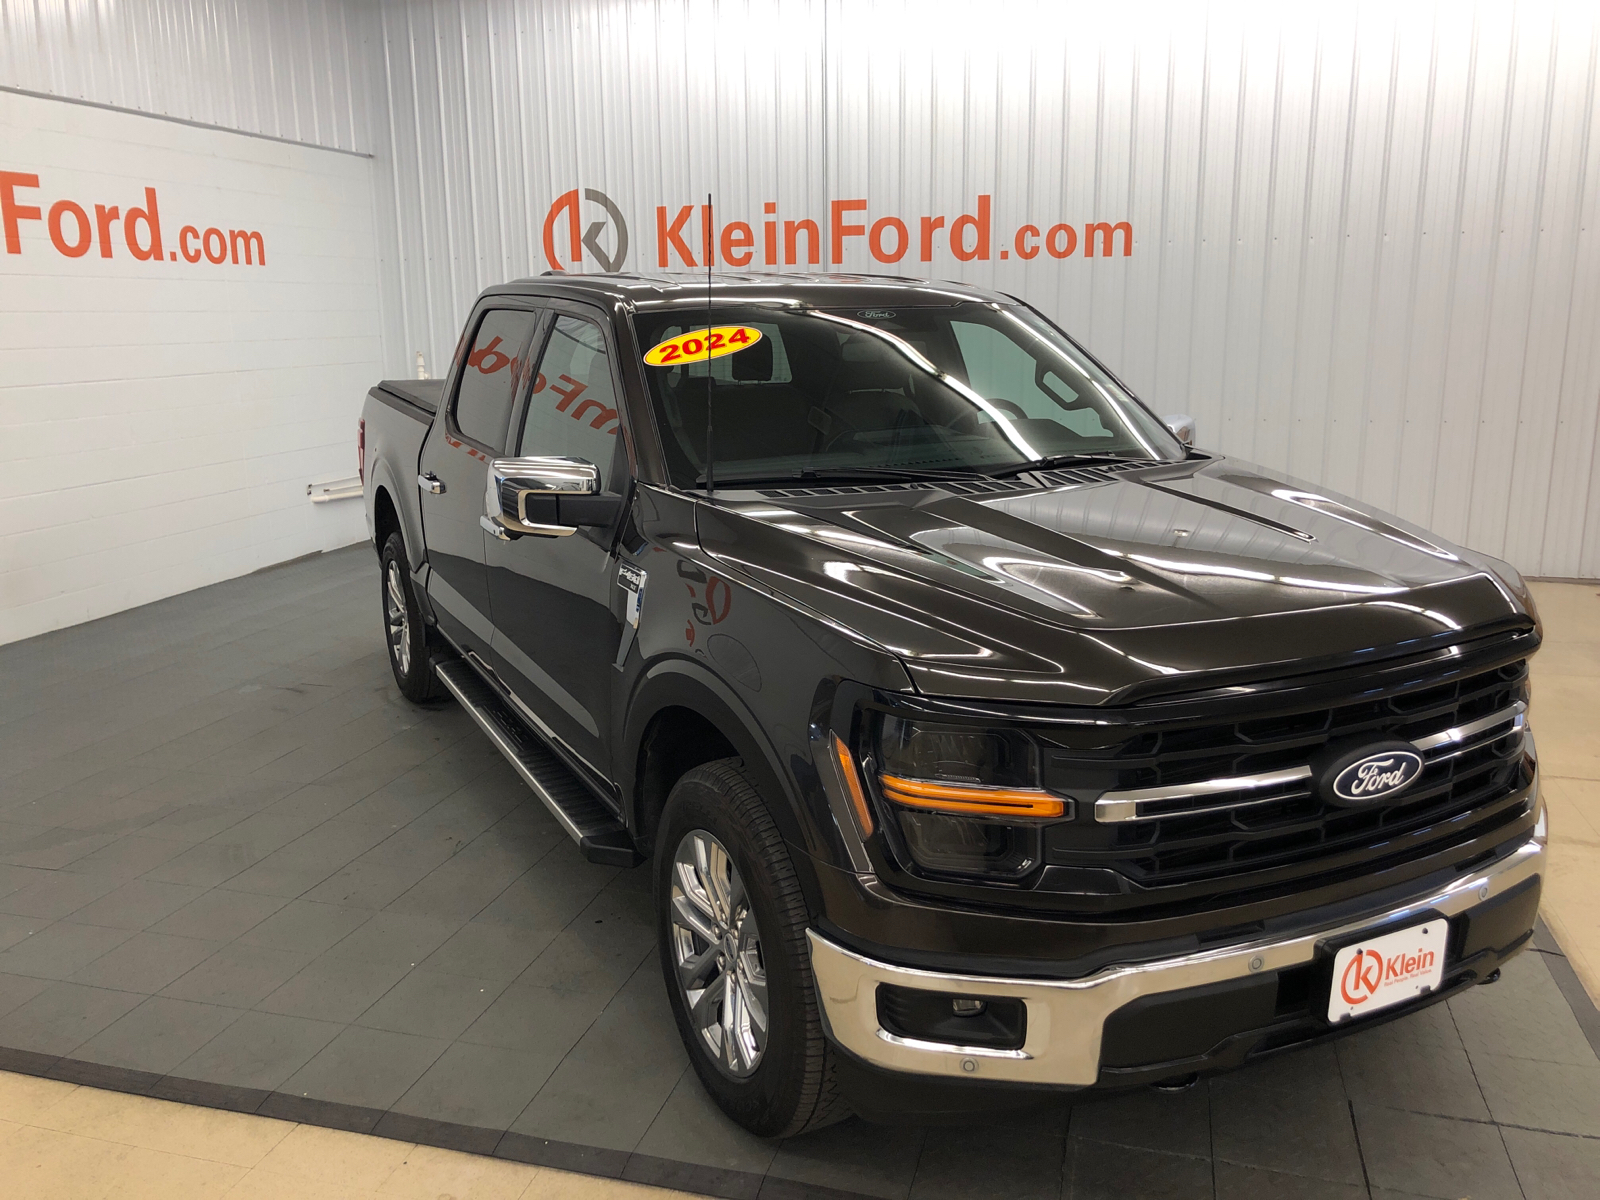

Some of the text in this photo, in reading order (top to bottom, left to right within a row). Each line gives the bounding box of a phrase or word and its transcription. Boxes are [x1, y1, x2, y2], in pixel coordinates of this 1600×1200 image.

[656, 195, 1133, 267] KleinFord.com
[864, 310, 890, 318] Ford
[659, 328, 750, 363] 2024
[1351, 758, 1407, 795] Ford
[1384, 947, 1435, 981] Klein
